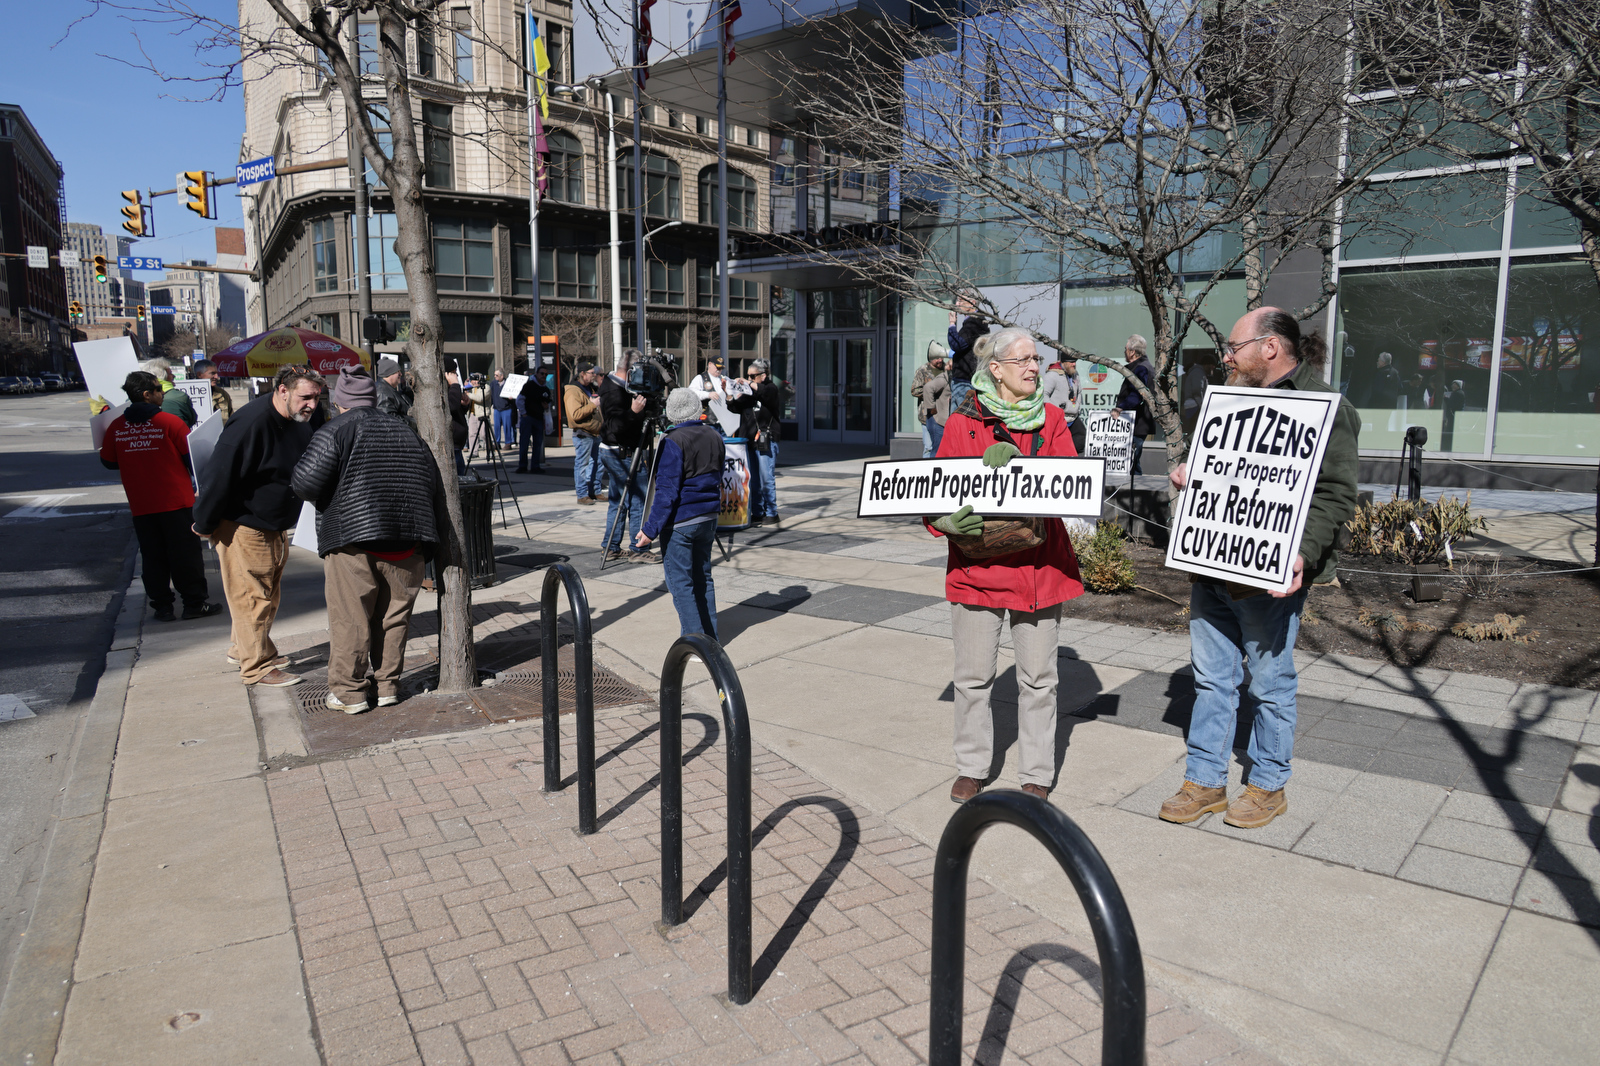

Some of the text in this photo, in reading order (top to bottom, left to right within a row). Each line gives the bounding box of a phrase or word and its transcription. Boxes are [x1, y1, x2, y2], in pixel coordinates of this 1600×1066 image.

[237, 159, 274, 183] Prospect
[120, 257, 160, 269] E. 9 St
[190, 385, 207, 395] the
[124, 419, 154, 428] S.O.S.
[1090, 416, 1131, 434] CITIZENS
[1202, 404, 1317, 460] CITIZENS
[130, 440, 152, 448] NOW
[1104, 434, 1128, 444] Property
[1089, 443, 1127, 457] Tax Reform
[1204, 454, 1302, 492] For Property
[869, 466, 1093, 507] ReformPropertyTax.com
[1188, 480, 1294, 534] Tax Reform
[1181, 526, 1282, 575] CUYAHOGA
